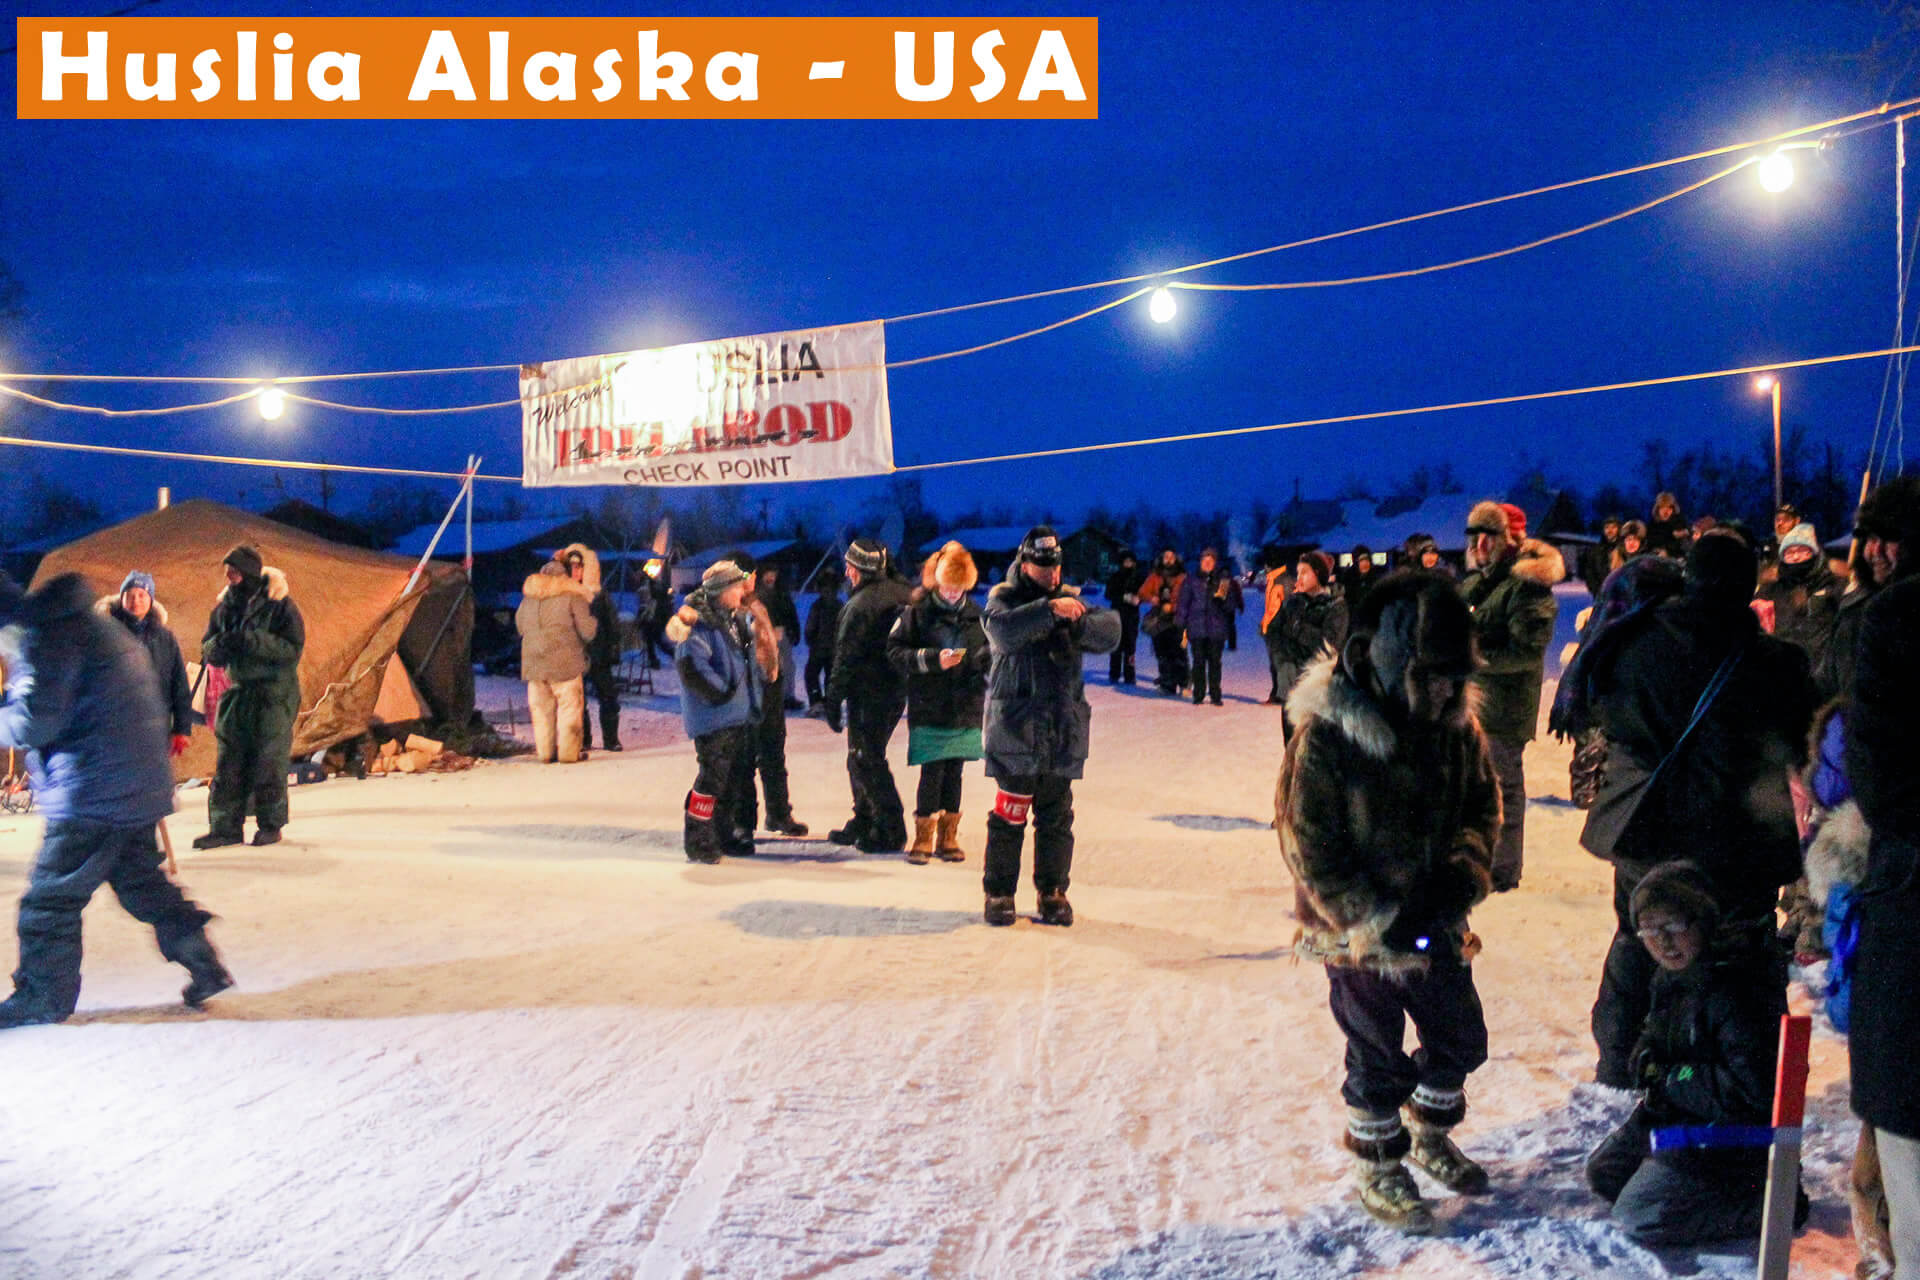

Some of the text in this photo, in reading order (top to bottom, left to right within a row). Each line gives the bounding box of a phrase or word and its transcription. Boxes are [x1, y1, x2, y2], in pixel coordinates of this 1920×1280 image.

[690, 340, 825, 391] USLIA
[554, 401, 854, 468] IDIROD
[623, 455, 792, 486] CHECK POINT
